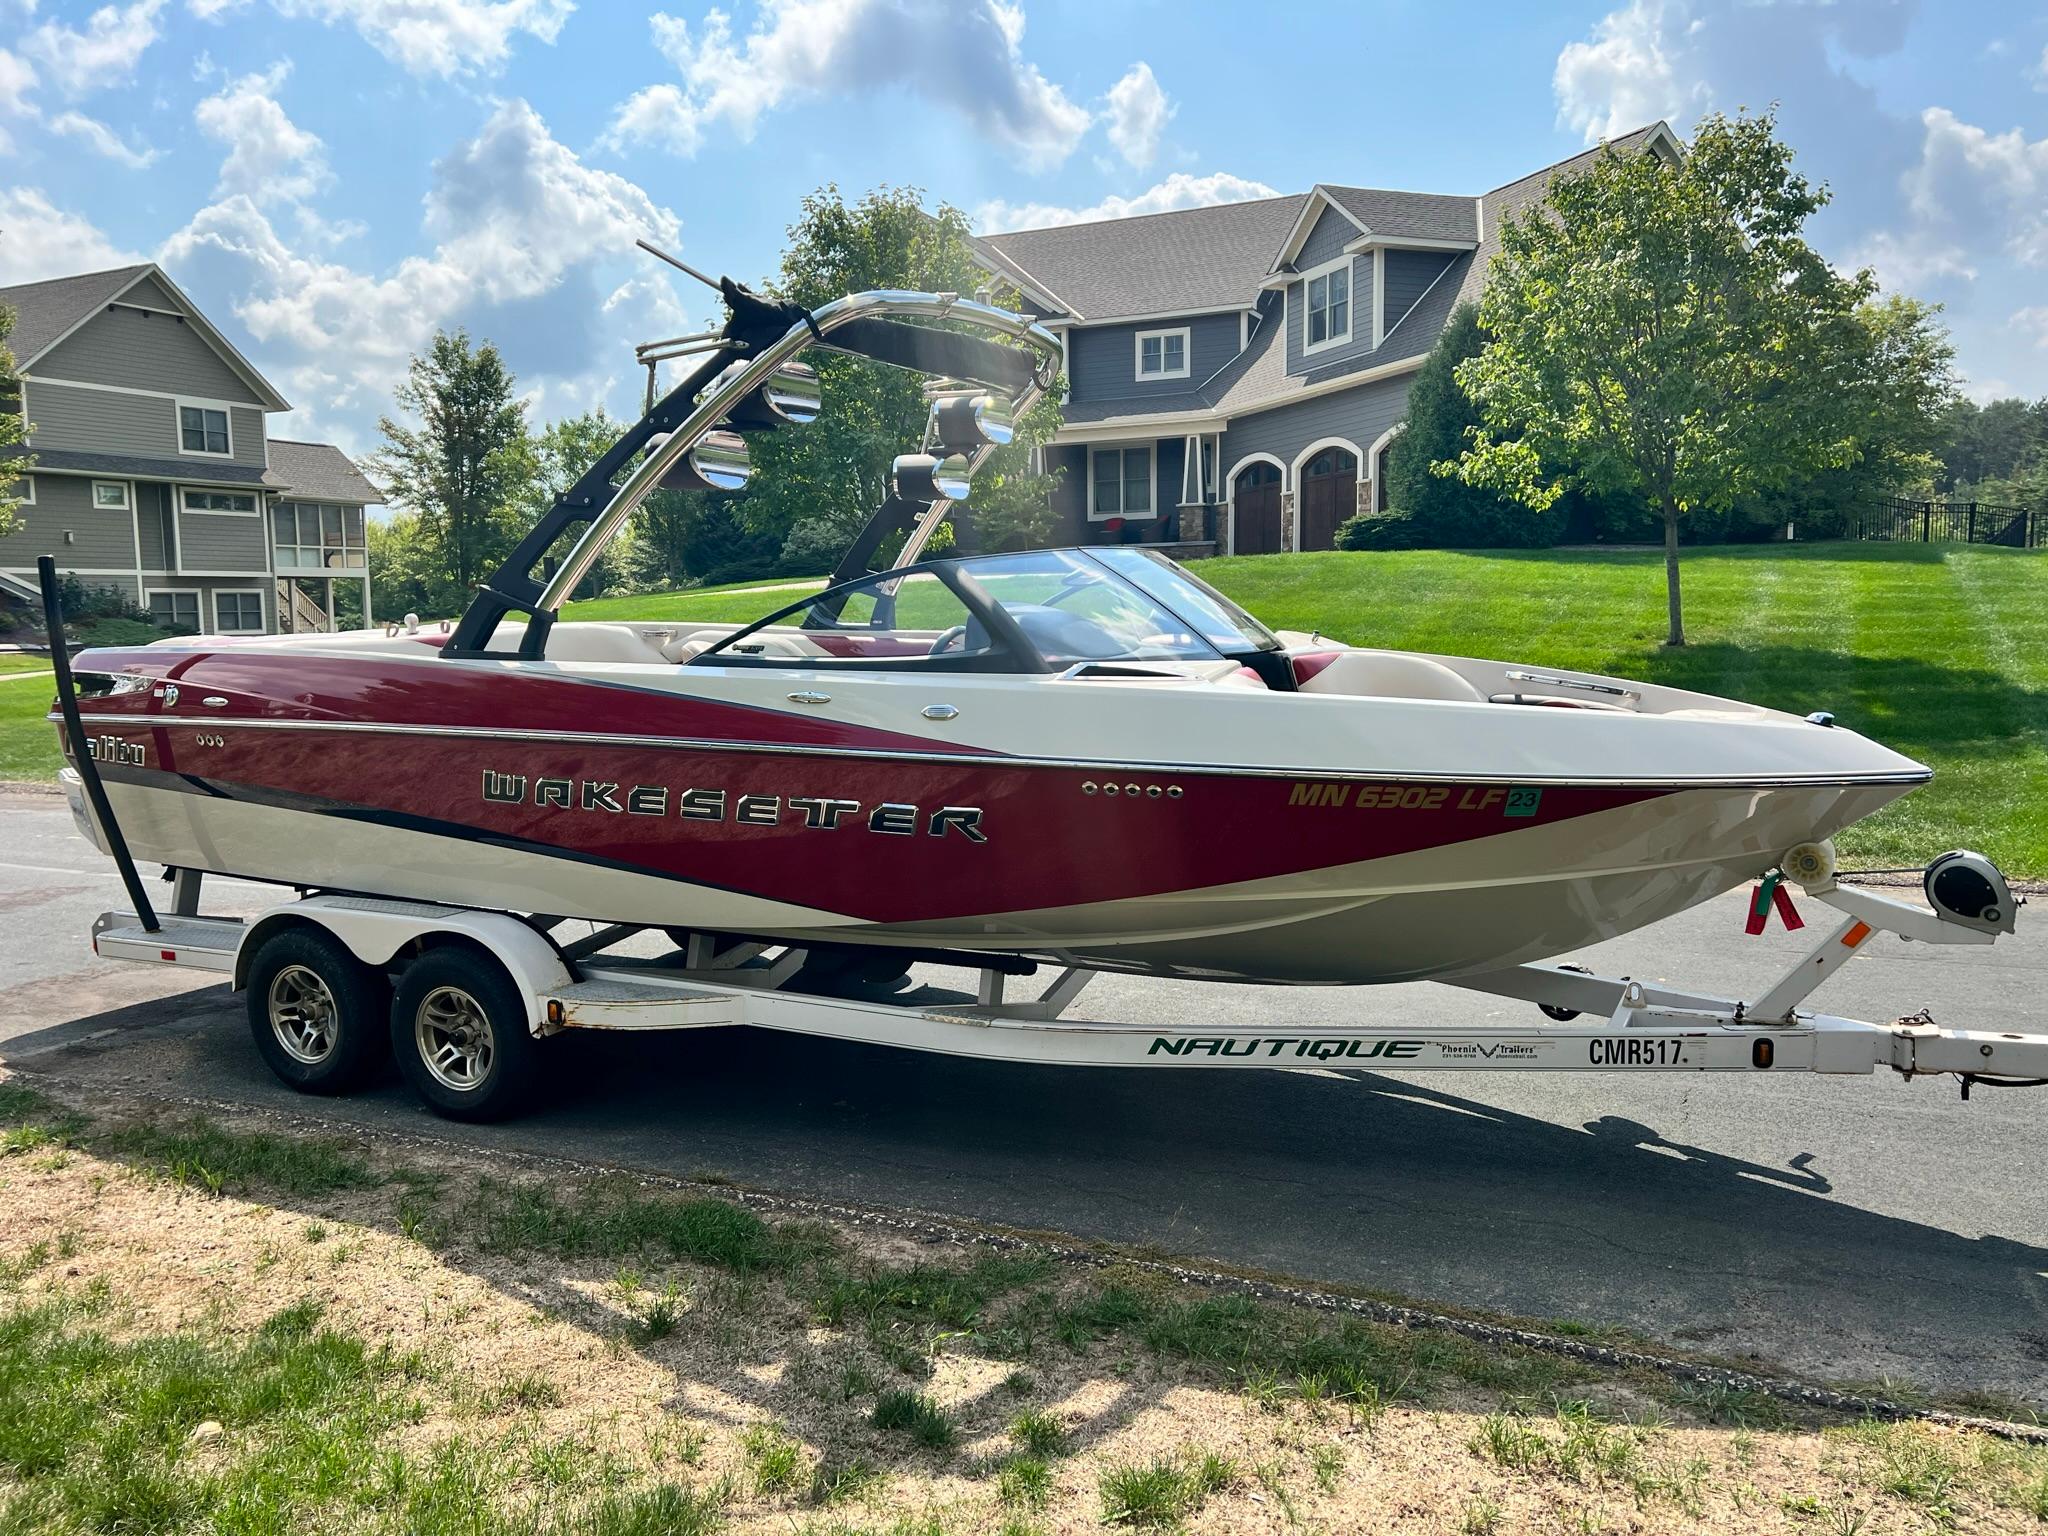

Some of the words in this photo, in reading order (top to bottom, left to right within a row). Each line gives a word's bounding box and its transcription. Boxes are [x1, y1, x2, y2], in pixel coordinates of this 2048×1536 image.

[482, 769, 988, 843] WAKESETTER
[1288, 783, 1350, 807] MN
[1355, 786, 1450, 809] 6302
[1456, 788, 1506, 810] LF
[1508, 792, 1537, 807] 23
[1147, 1037, 1426, 1060] NAUTIQUE
[1442, 1045, 1477, 1053] Phoenix
[1500, 1045, 1534, 1054] Trailers
[1589, 1039, 1682, 1065] CMR517
